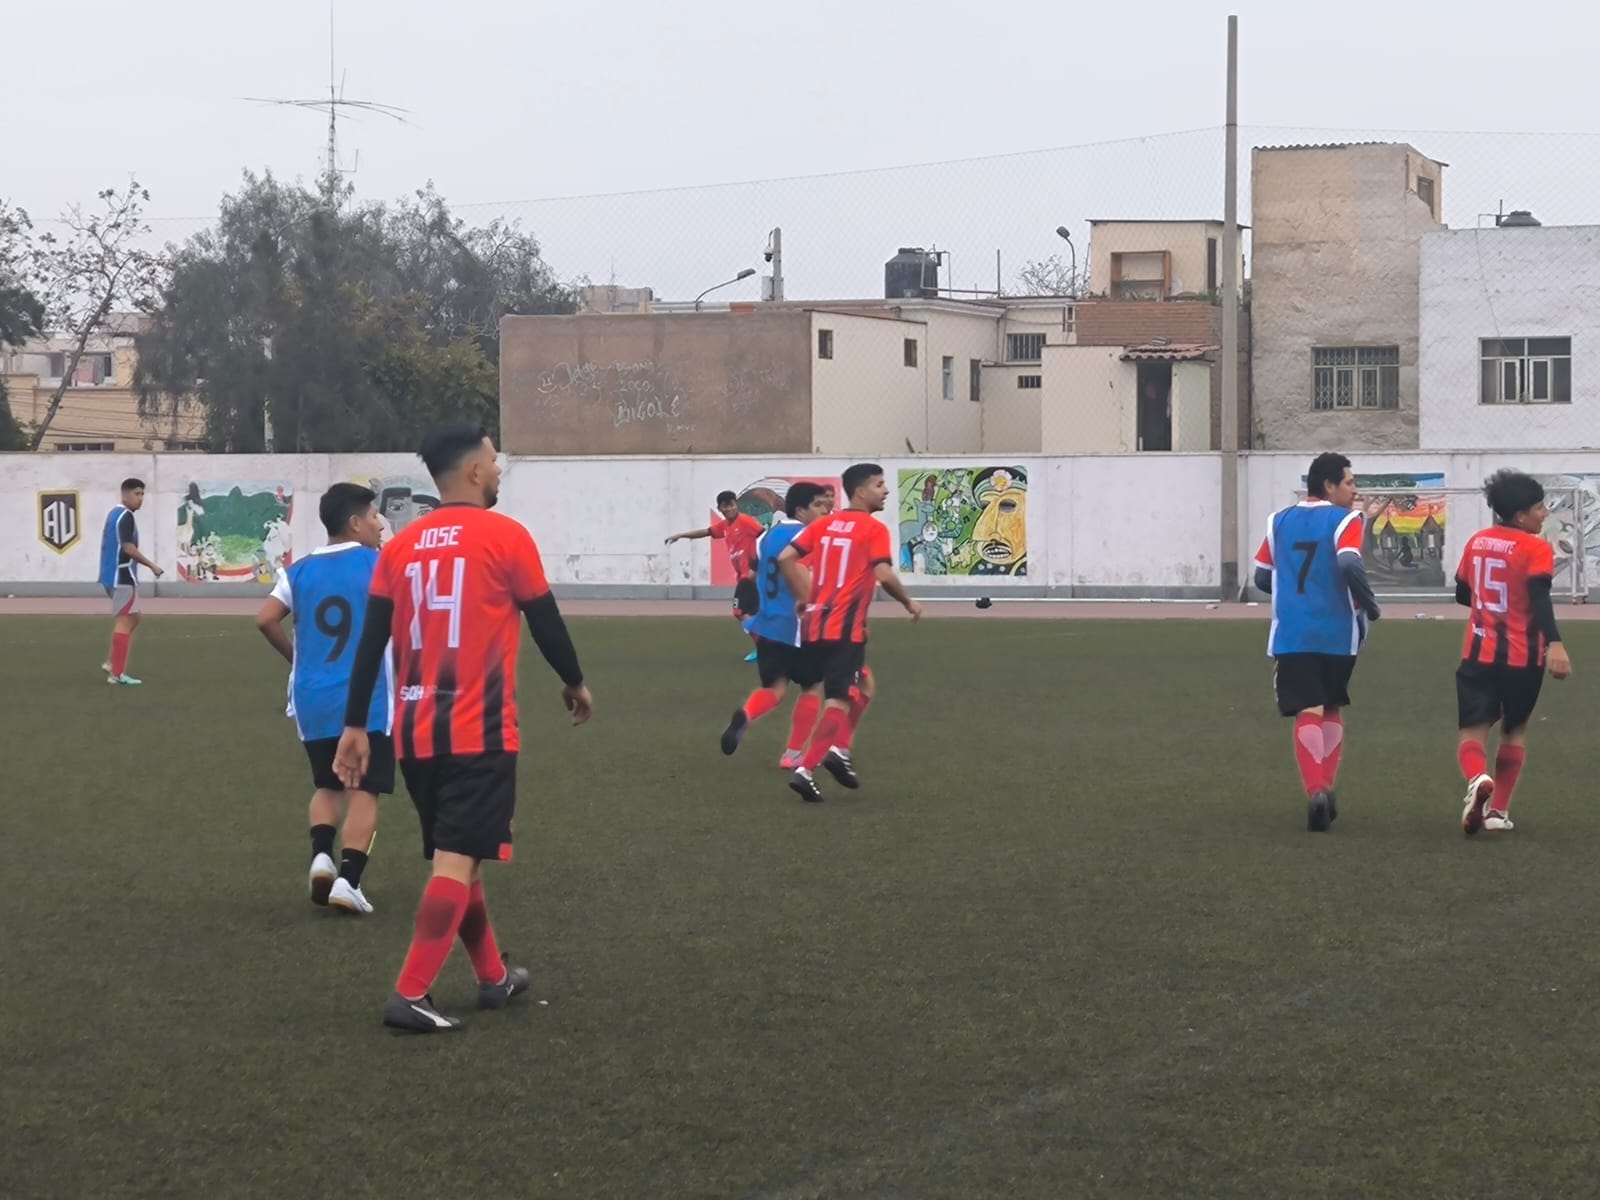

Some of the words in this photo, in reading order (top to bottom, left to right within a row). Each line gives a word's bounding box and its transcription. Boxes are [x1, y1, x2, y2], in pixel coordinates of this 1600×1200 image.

[414, 525, 463, 550] JOSE
[817, 536, 852, 588] 17
[1293, 542, 1319, 595] 7
[1473, 556, 1508, 613] 15
[314, 595, 353, 663] 9
[404, 557, 466, 650] 14
